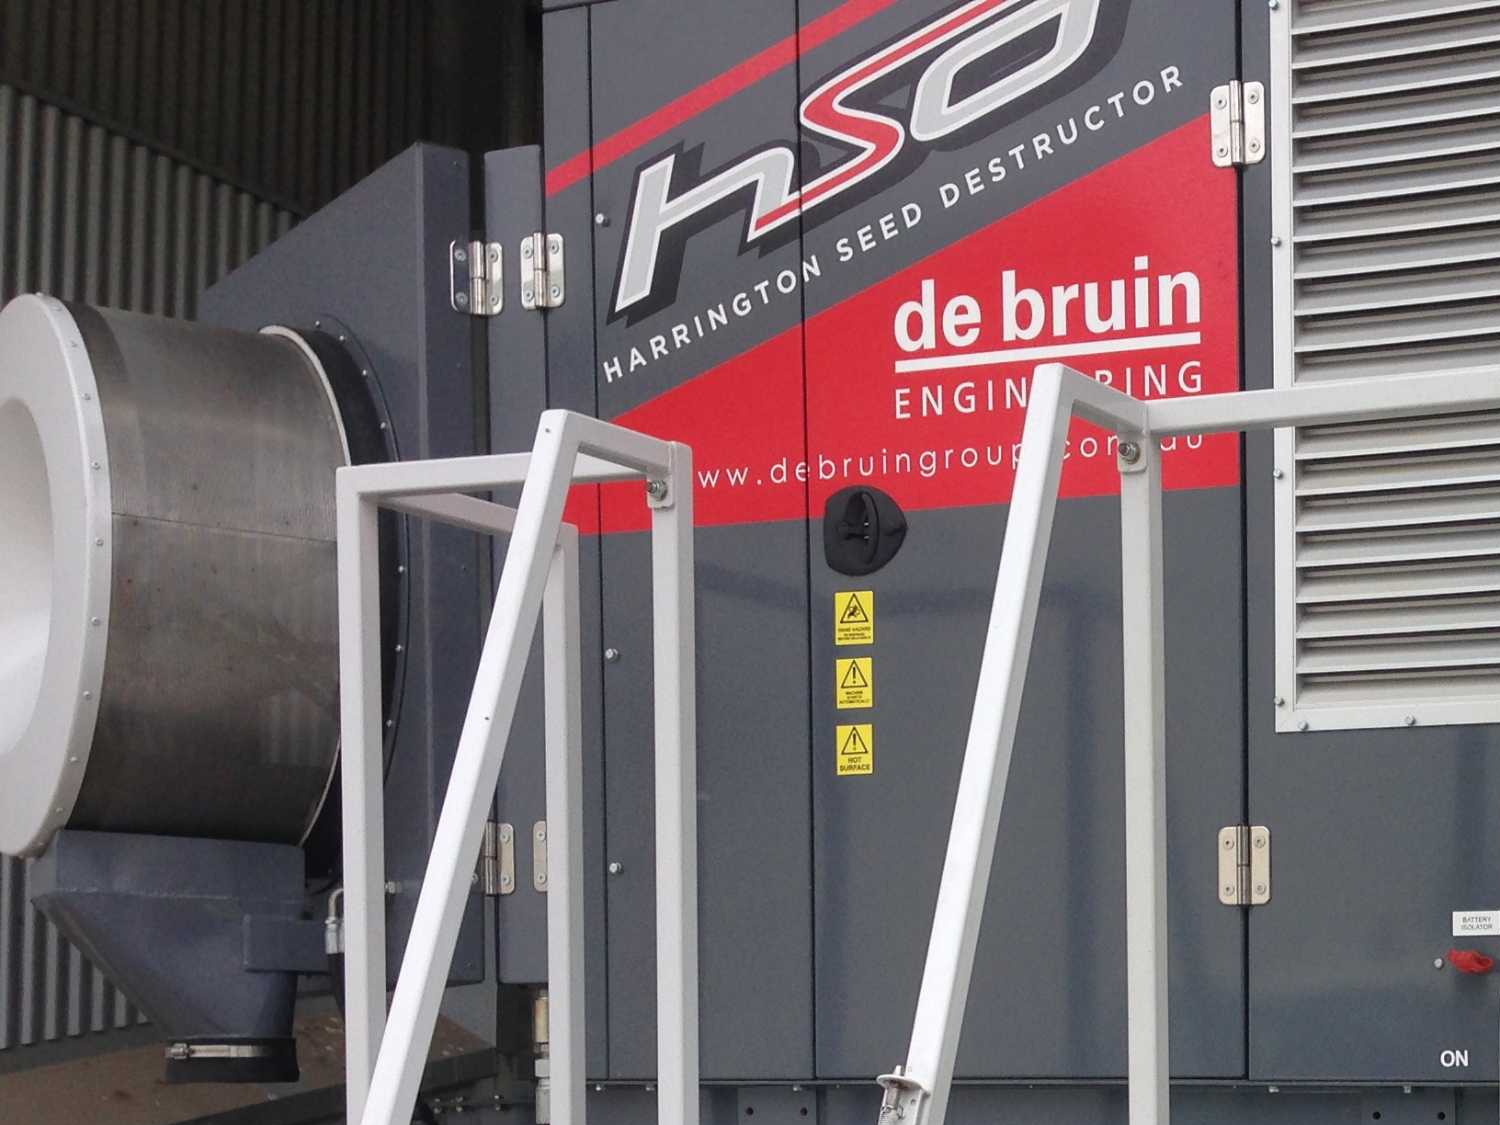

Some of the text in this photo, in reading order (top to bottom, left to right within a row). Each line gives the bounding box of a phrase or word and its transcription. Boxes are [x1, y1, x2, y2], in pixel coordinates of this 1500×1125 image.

[603, 64, 1185, 384] HARRINGTON SEED DESTRUCTOR
[894, 255, 1201, 352] de bruin
[895, 360, 1203, 420] ENGINING
[840, 763, 870, 771] SURFACE
[1440, 1049, 1469, 1068] ON
